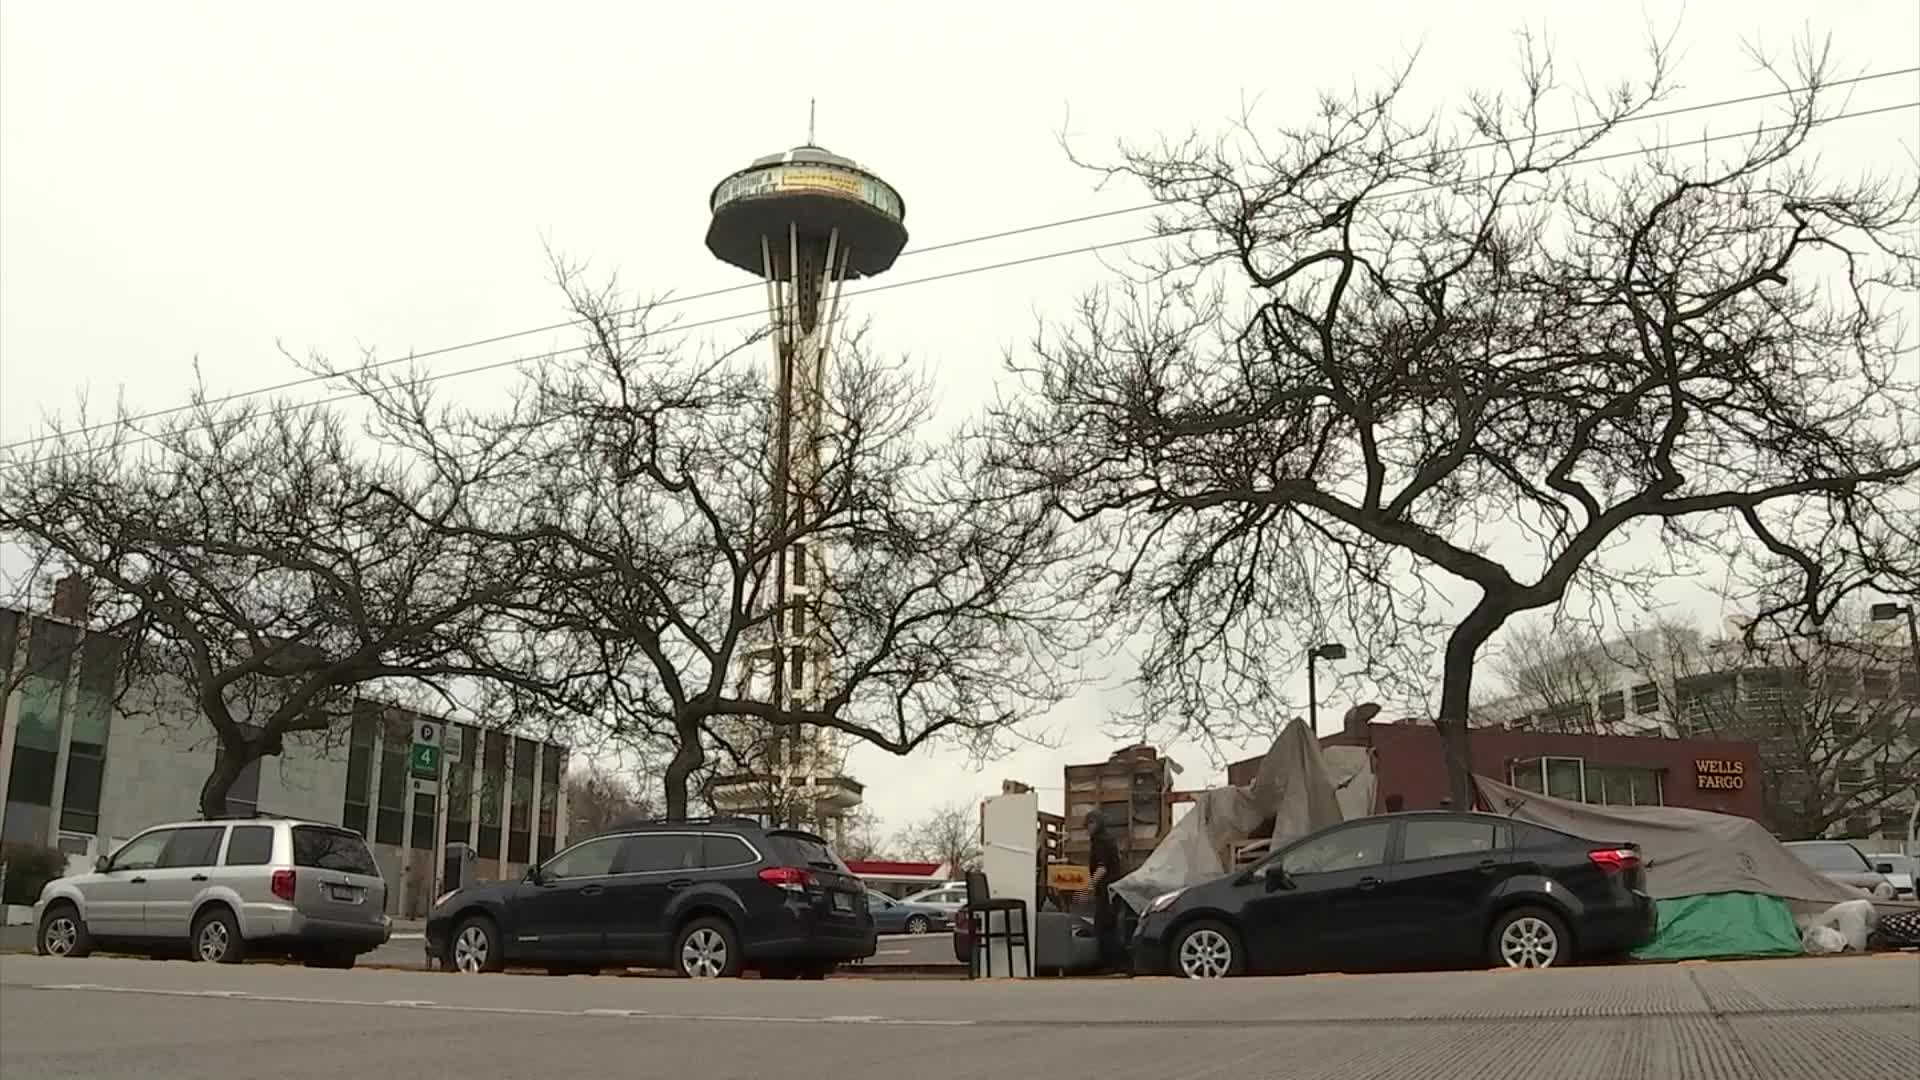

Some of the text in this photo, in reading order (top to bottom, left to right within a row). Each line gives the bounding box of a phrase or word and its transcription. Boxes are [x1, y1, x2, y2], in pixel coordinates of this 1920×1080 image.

[420, 748, 432, 765] 4
[1695, 759, 1744, 774] WELLS
[1697, 775, 1744, 789] FARGO
